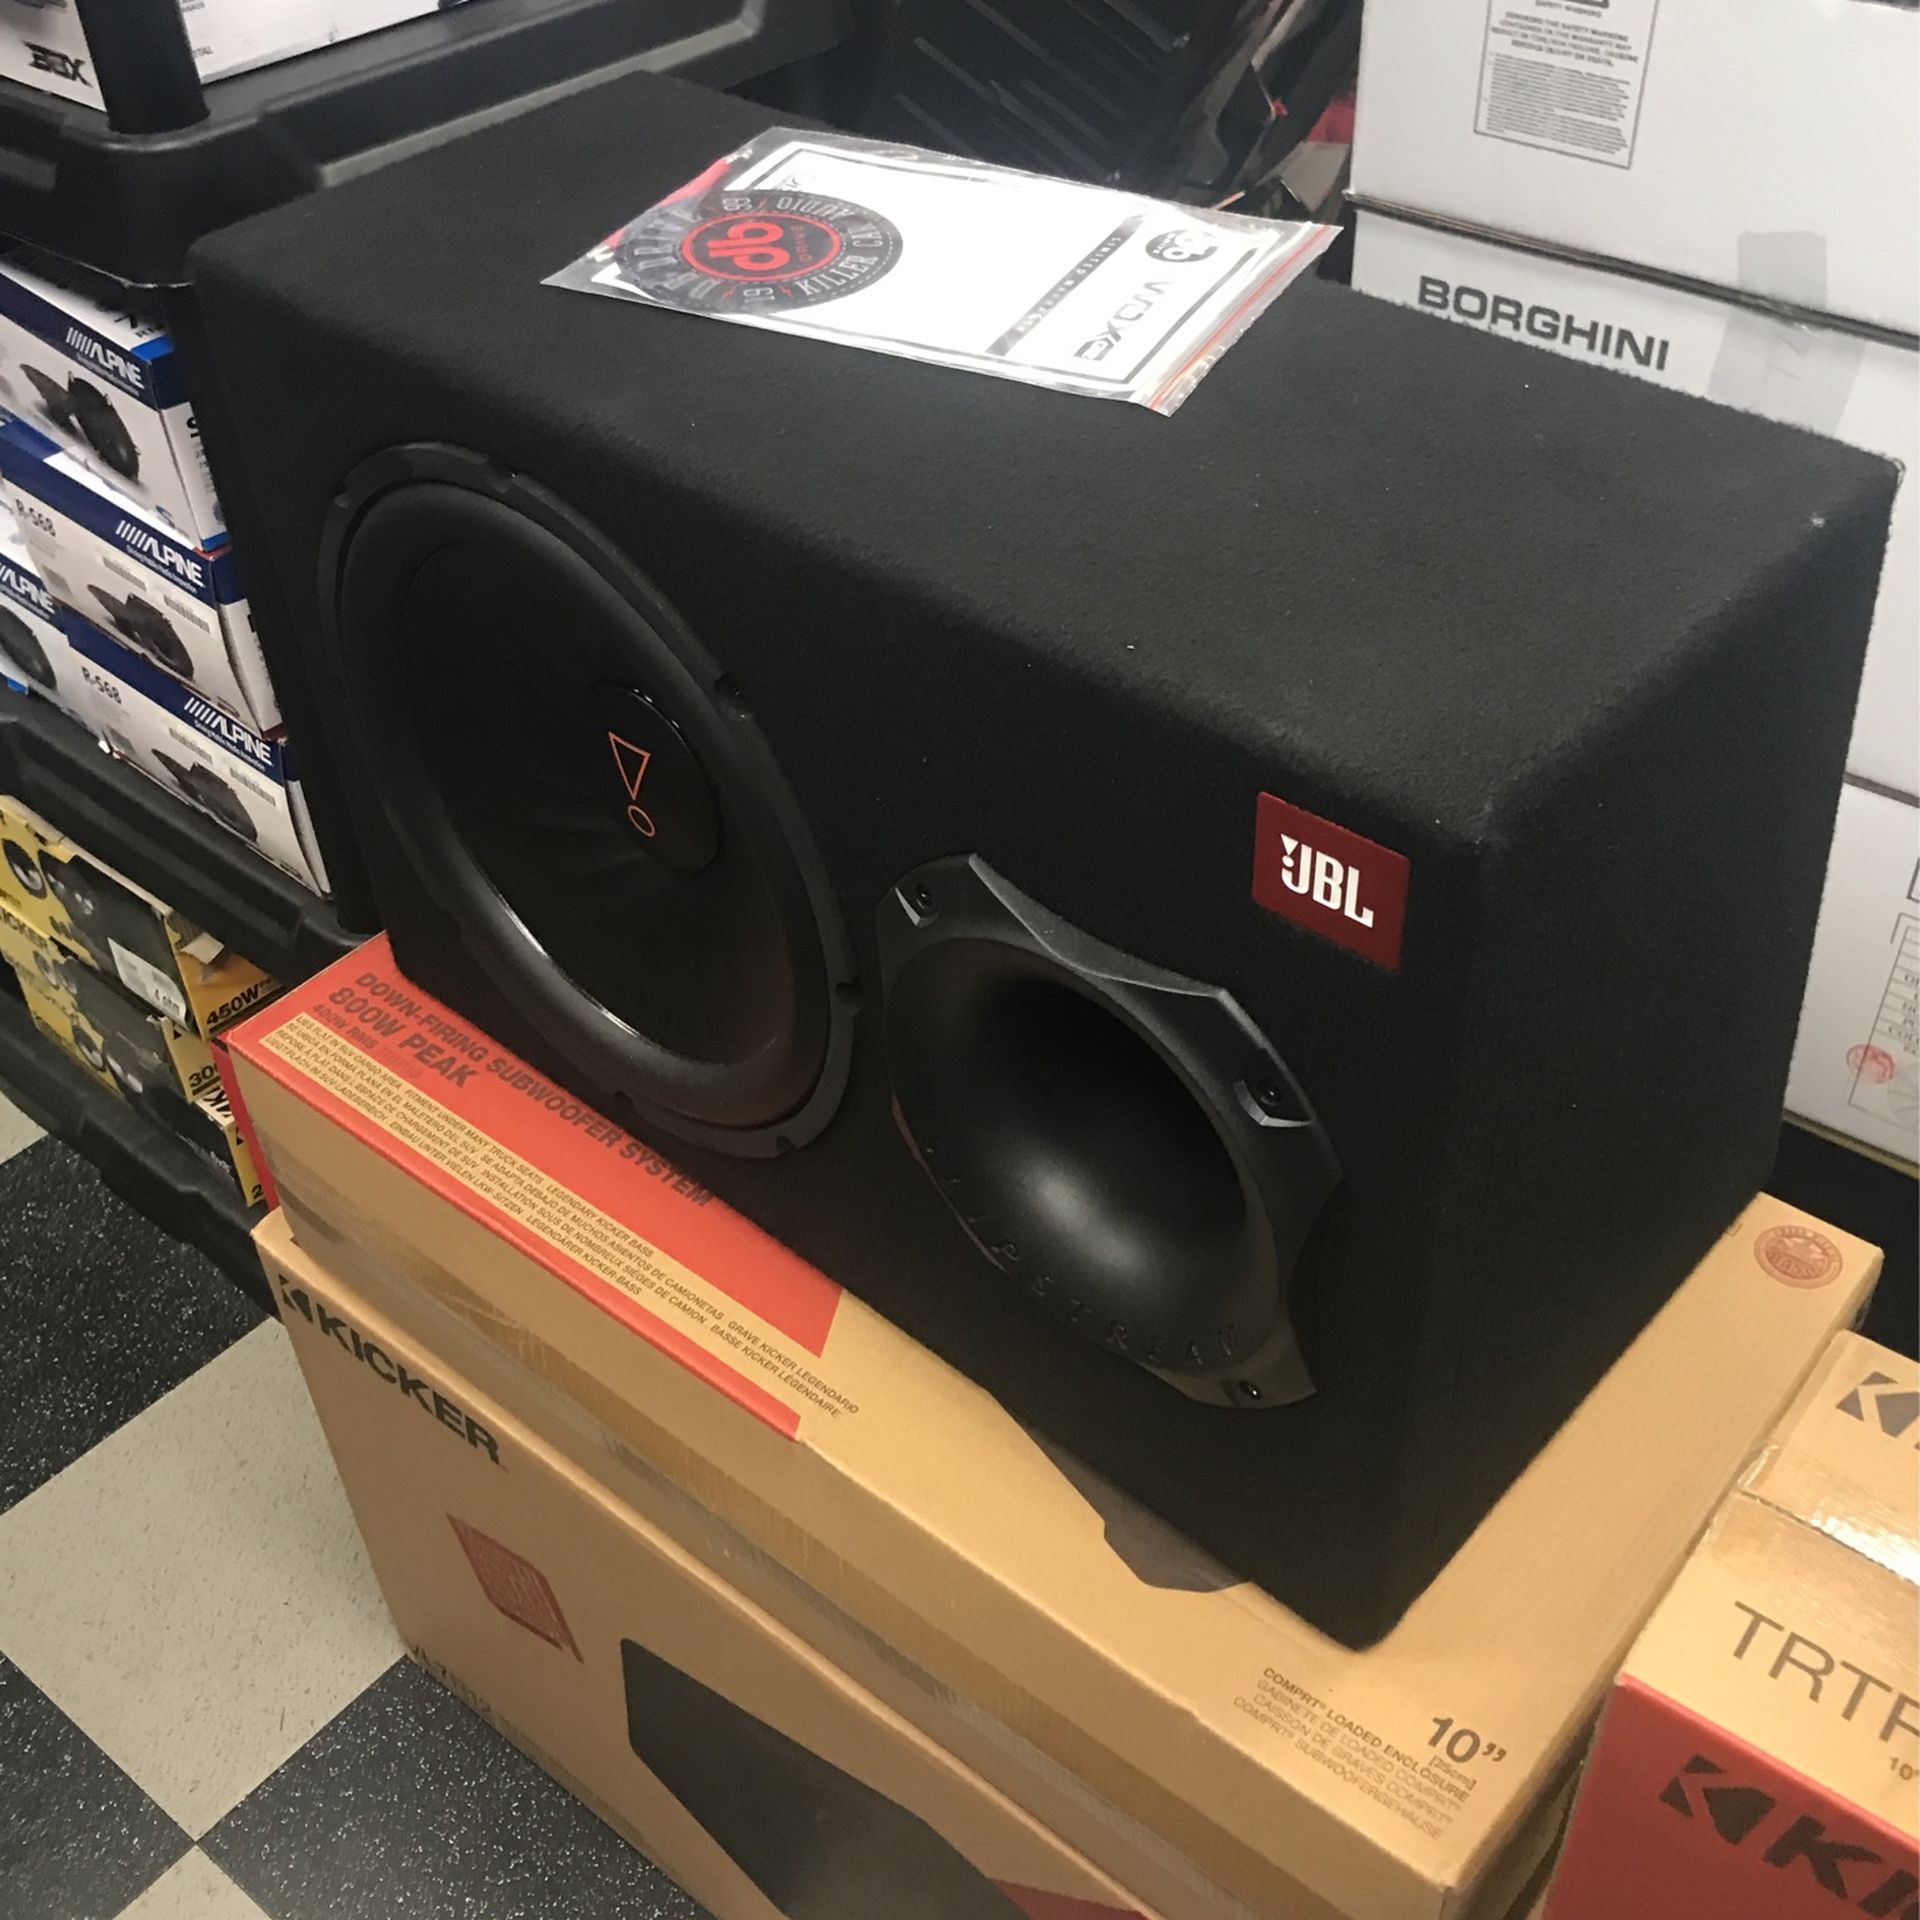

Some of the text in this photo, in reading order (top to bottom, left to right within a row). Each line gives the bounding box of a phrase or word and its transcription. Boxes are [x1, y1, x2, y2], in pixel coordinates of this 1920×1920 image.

[794, 255, 879, 296] KILLER
[1418, 274, 1669, 371] BORGHINI
[1281, 843, 1374, 929] JBL
[206, 984, 259, 1026] 450W
[329, 987, 406, 1037] 800W
[400, 1032, 478, 1088] PEAK
[349, 1026, 378, 1050] RMS
[188, 1063, 217, 1089] 30
[355, 972, 488, 1062] DOWN-FIRING
[487, 1058, 622, 1149] SUBWOOFER
[619, 1141, 713, 1207] SYSTEM
[351, 1053, 384, 1076] CARGO
[377, 1070, 404, 1090] AREA
[402, 1087, 440, 1114] FITMENT
[435, 1109, 470, 1134] UNDER
[462, 1127, 490, 1148] MANY
[487, 1144, 518, 1167] TRUCK
[515, 1162, 545, 1185] SEATS
[545, 1182, 598, 1222] LEGENDARY
[594, 1215, 631, 1243] KICKER
[627, 1236, 655, 1260] BASS
[326, 1064, 352, 1082] DANS
[382, 1101, 398, 1114] DE
[393, 1109, 450, 1150] CHARGEMENT
[446, 1145, 462, 1158] DE
[458, 1153, 480, 1170] SUV
[479, 1167, 539, 1211] INSTALLATION
[535, 1205, 562, 1227] SOUS
[558, 1221, 574, 1235] DE
[572, 1230, 623, 1269] NOMBREUX
[652, 1284, 669, 1300] DE
[667, 1294, 706, 1326] CAMION
[709, 1322, 742, 1351] BASSE
[740, 1343, 778, 1376] KICKER
[327, 1050, 359, 1073] FORMA
[354, 1068, 383, 1090] PLANA
[379, 1085, 395, 1098] EN
[390, 1093, 405, 1105] EL
[400, 1100, 446, 1133] MALETERO
[441, 1127, 463, 1144] DEL
[458, 1138, 479, 1155] SUV
[479, 1152, 495, 1166] SE
[490, 1160, 526, 1187] ADAPTA
[522, 1181, 560, 1210] DEBAJO
[555, 1204, 571, 1218] DE
[568, 1212, 610, 1245] MUCHOS
[606, 1238, 652, 1273] ASIENTOS
[649, 1266, 665, 1282] DE
[662, 1275, 724, 1322] CAMIONETAS
[726, 1318, 760, 1347] GRAVE
[758, 1340, 797, 1373] KICKER
[795, 1365, 859, 1417] LEGENDARIO
[416, 1140, 448, 1163] UNTER
[581, 1251, 642, 1296] KICKER-BASS
[317, 1303, 500, 1466] KICKER
[1257, 1679, 1319, 1727] GABINETE
[1320, 1720, 1340, 1738] DE
[1311, 1731, 1331, 1749] DE
[1326, 1708, 1383, 1748] LOADED
[1384, 1744, 1470, 1803] ENCLOSURE
